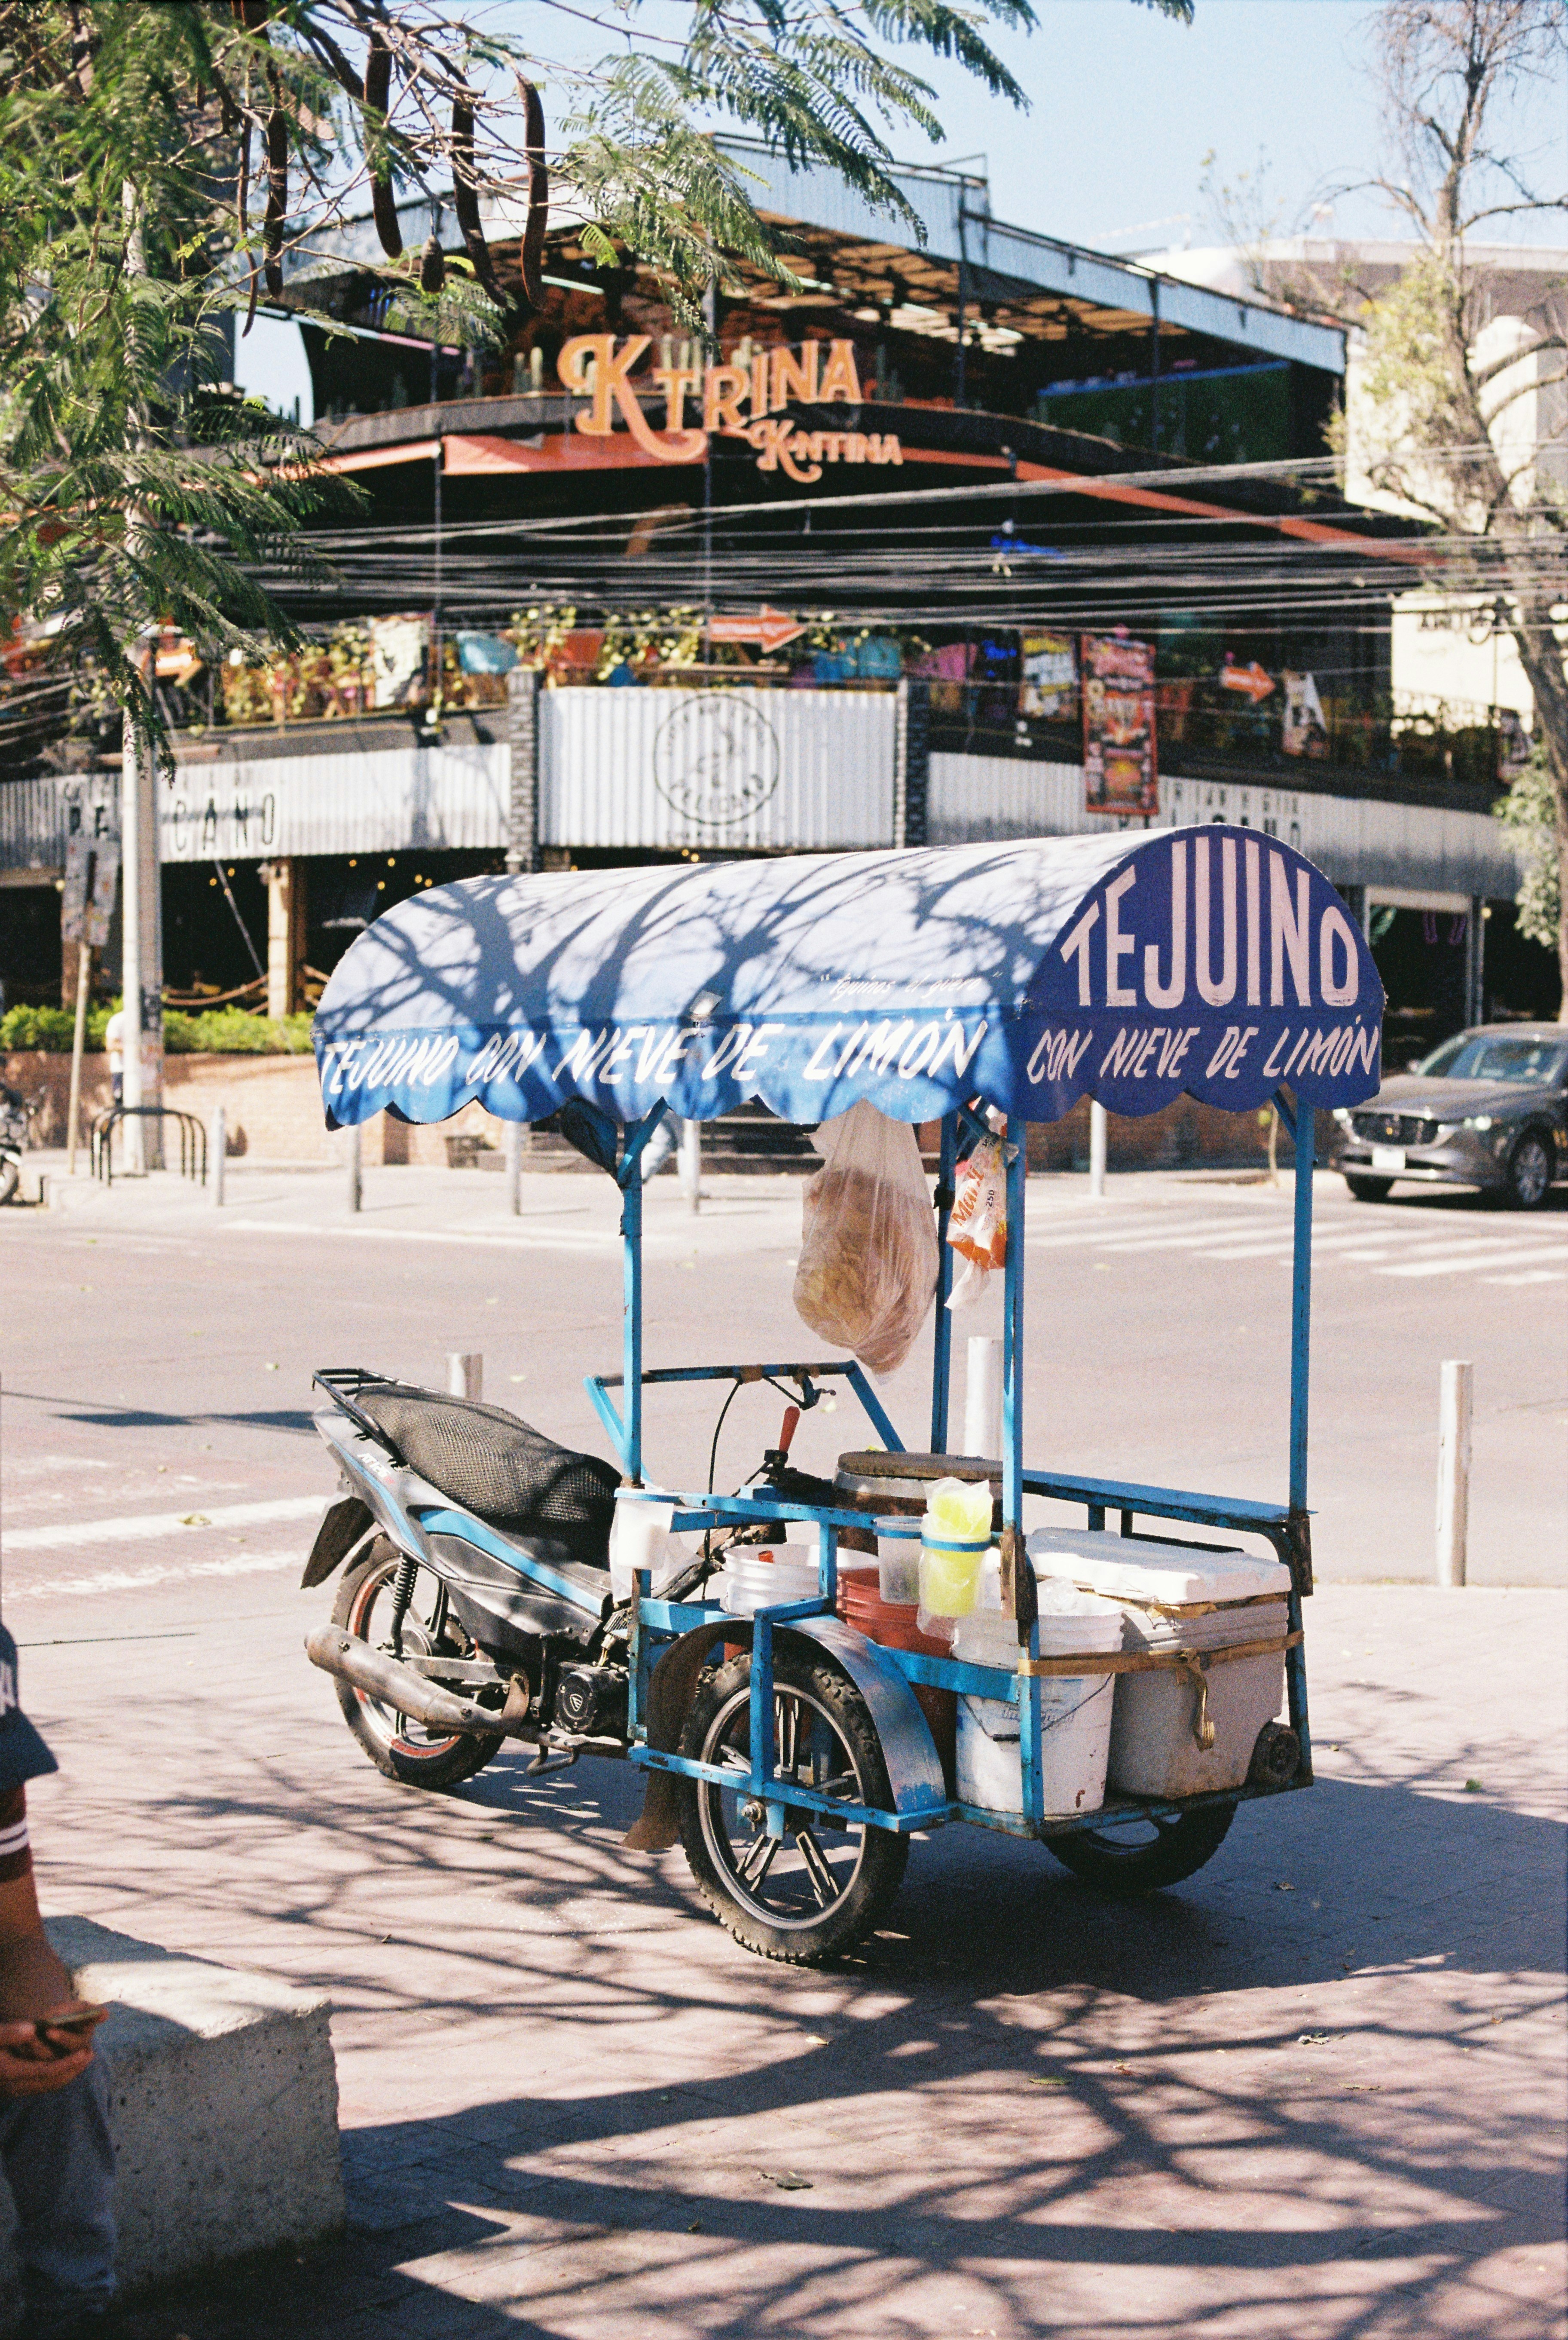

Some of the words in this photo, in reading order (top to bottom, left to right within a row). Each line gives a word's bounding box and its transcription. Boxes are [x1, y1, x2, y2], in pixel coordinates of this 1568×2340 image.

[1060, 828, 1359, 1009] TEJUINO
[905, 973, 931, 992] el
[321, 1035, 459, 1094] TEJUINO
[465, 1032, 547, 1085] CON
[552, 1026, 699, 1084] NIEVE
[701, 1023, 785, 1081] DE
[803, 1008, 988, 1080] LIMÓN
[1027, 1029, 1092, 1084] CON
[1100, 1026, 1200, 1079] NIEVE
[1206, 1026, 1259, 1079] DE
[1263, 1014, 1378, 1077] LIMÓN
